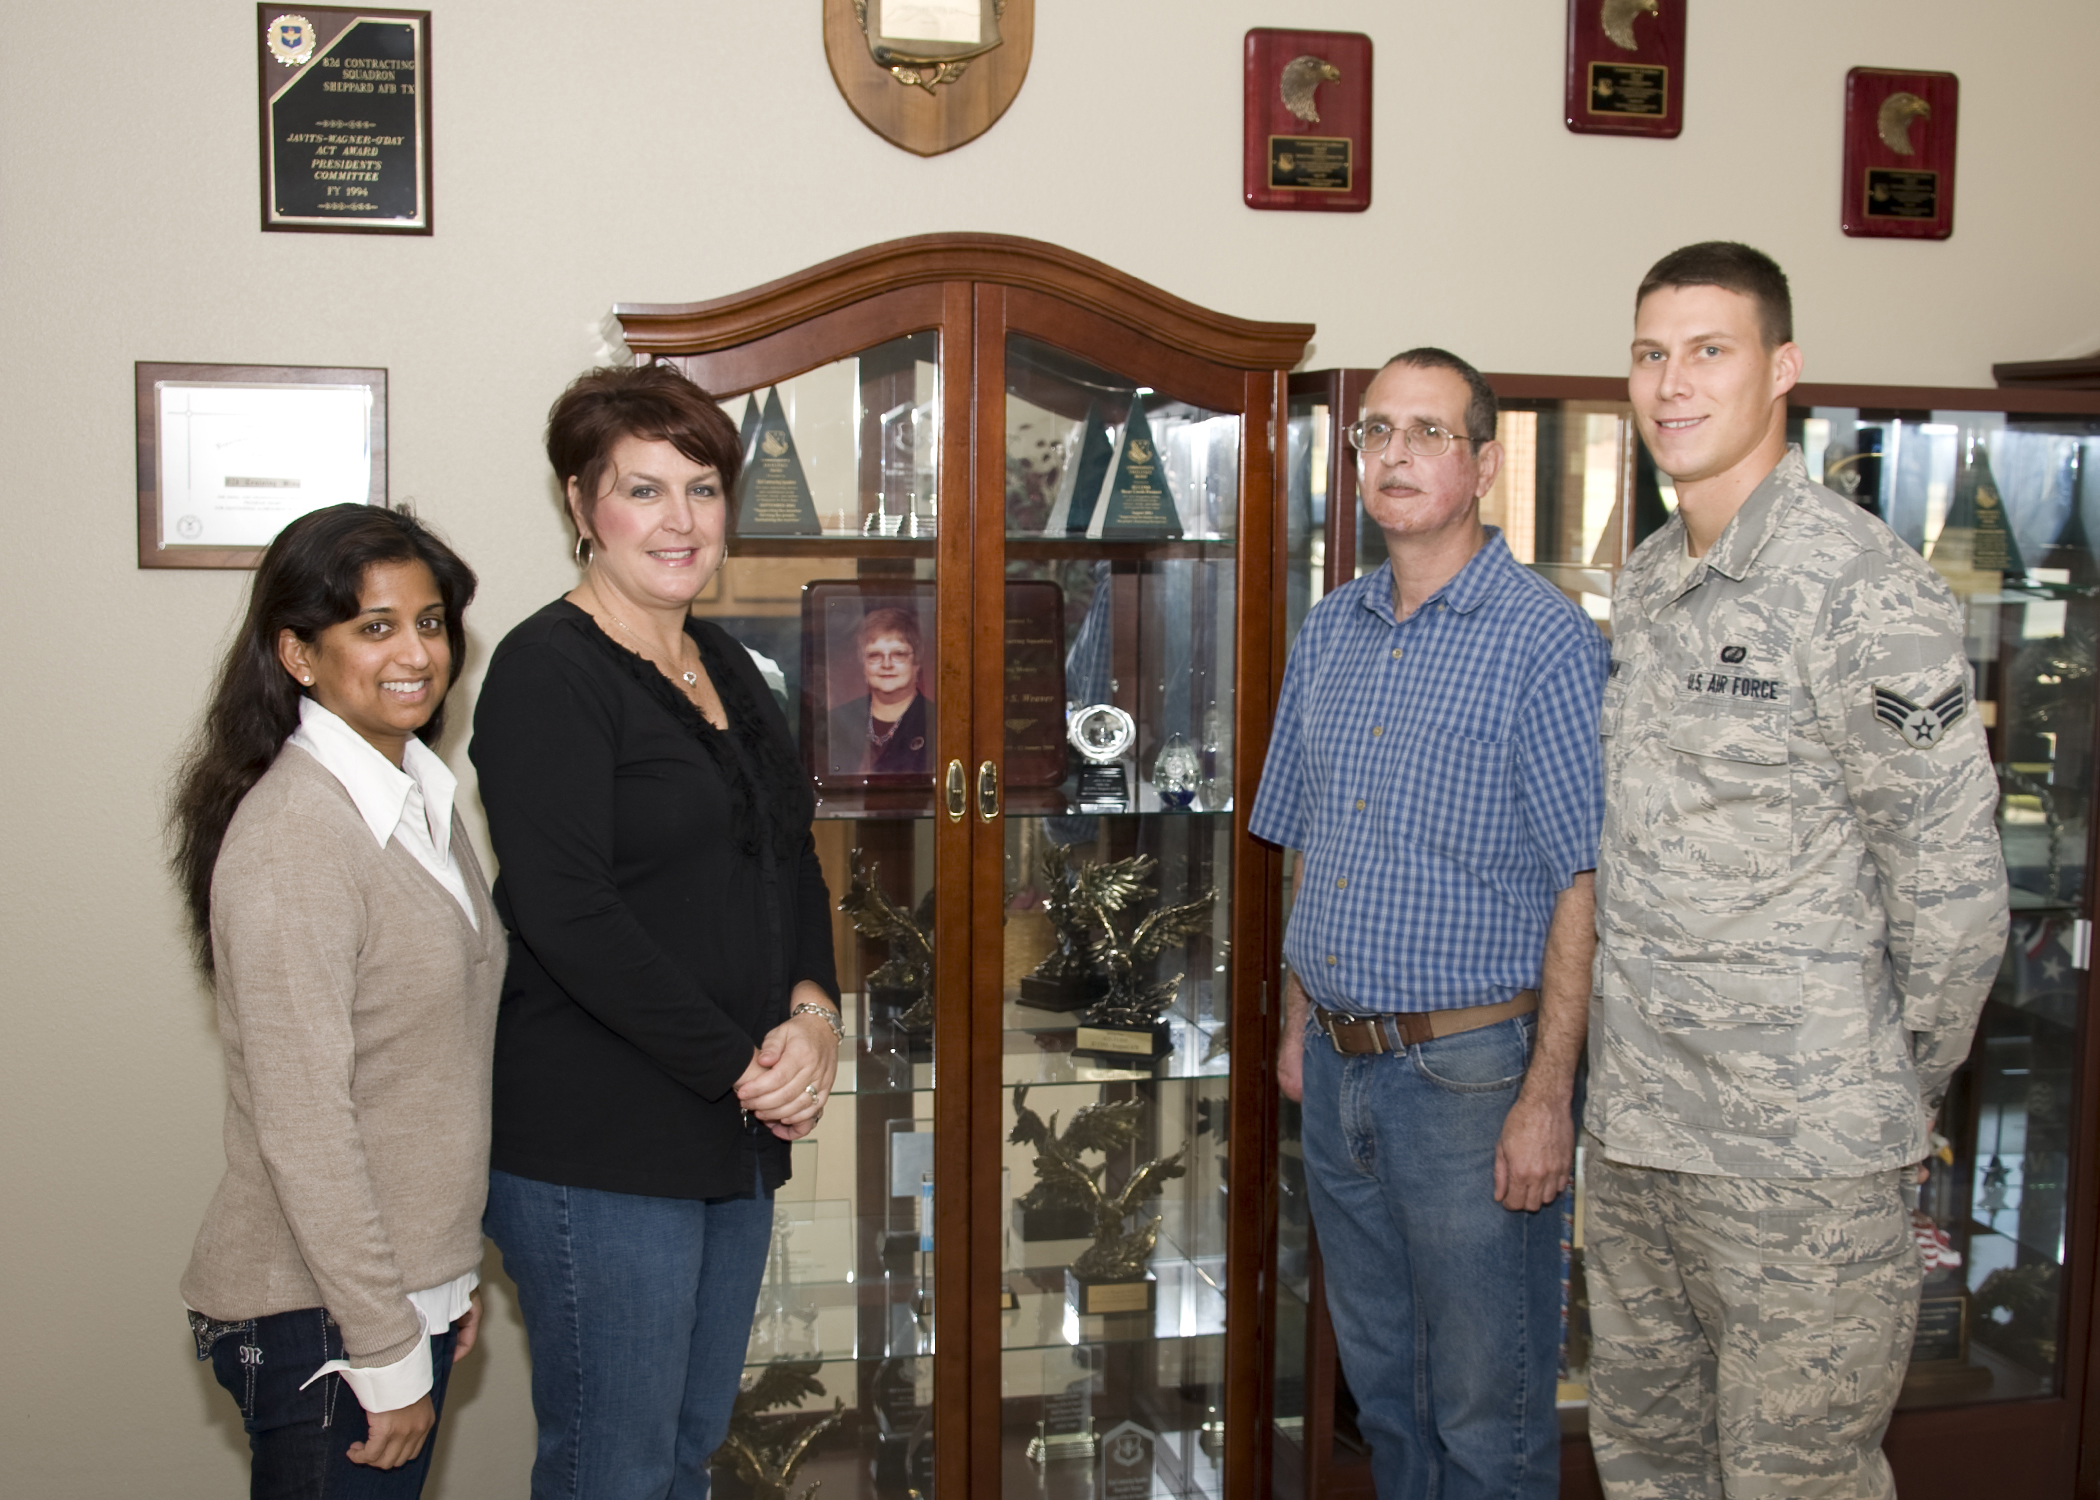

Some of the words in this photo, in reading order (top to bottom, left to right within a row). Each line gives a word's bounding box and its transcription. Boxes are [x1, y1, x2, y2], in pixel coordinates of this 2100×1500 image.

[344, 58, 415, 70] CONTRACTING
[342, 69, 396, 81] SQUADRON
[322, 81, 375, 93] SHEPPARD
[377, 83, 397, 94] AFB
[400, 84, 415, 94] TX
[315, 145, 338, 155] ACT
[342, 146, 379, 156] AWARD
[310, 159, 383, 171] PRESIDENT'S
[313, 171, 379, 181] COMMITTEE
[326, 186, 341, 196] FY
[345, 187, 369, 197] 1994
[1707, 674, 1729, 694] AIR
[1732, 677, 1778, 700] FORCE
